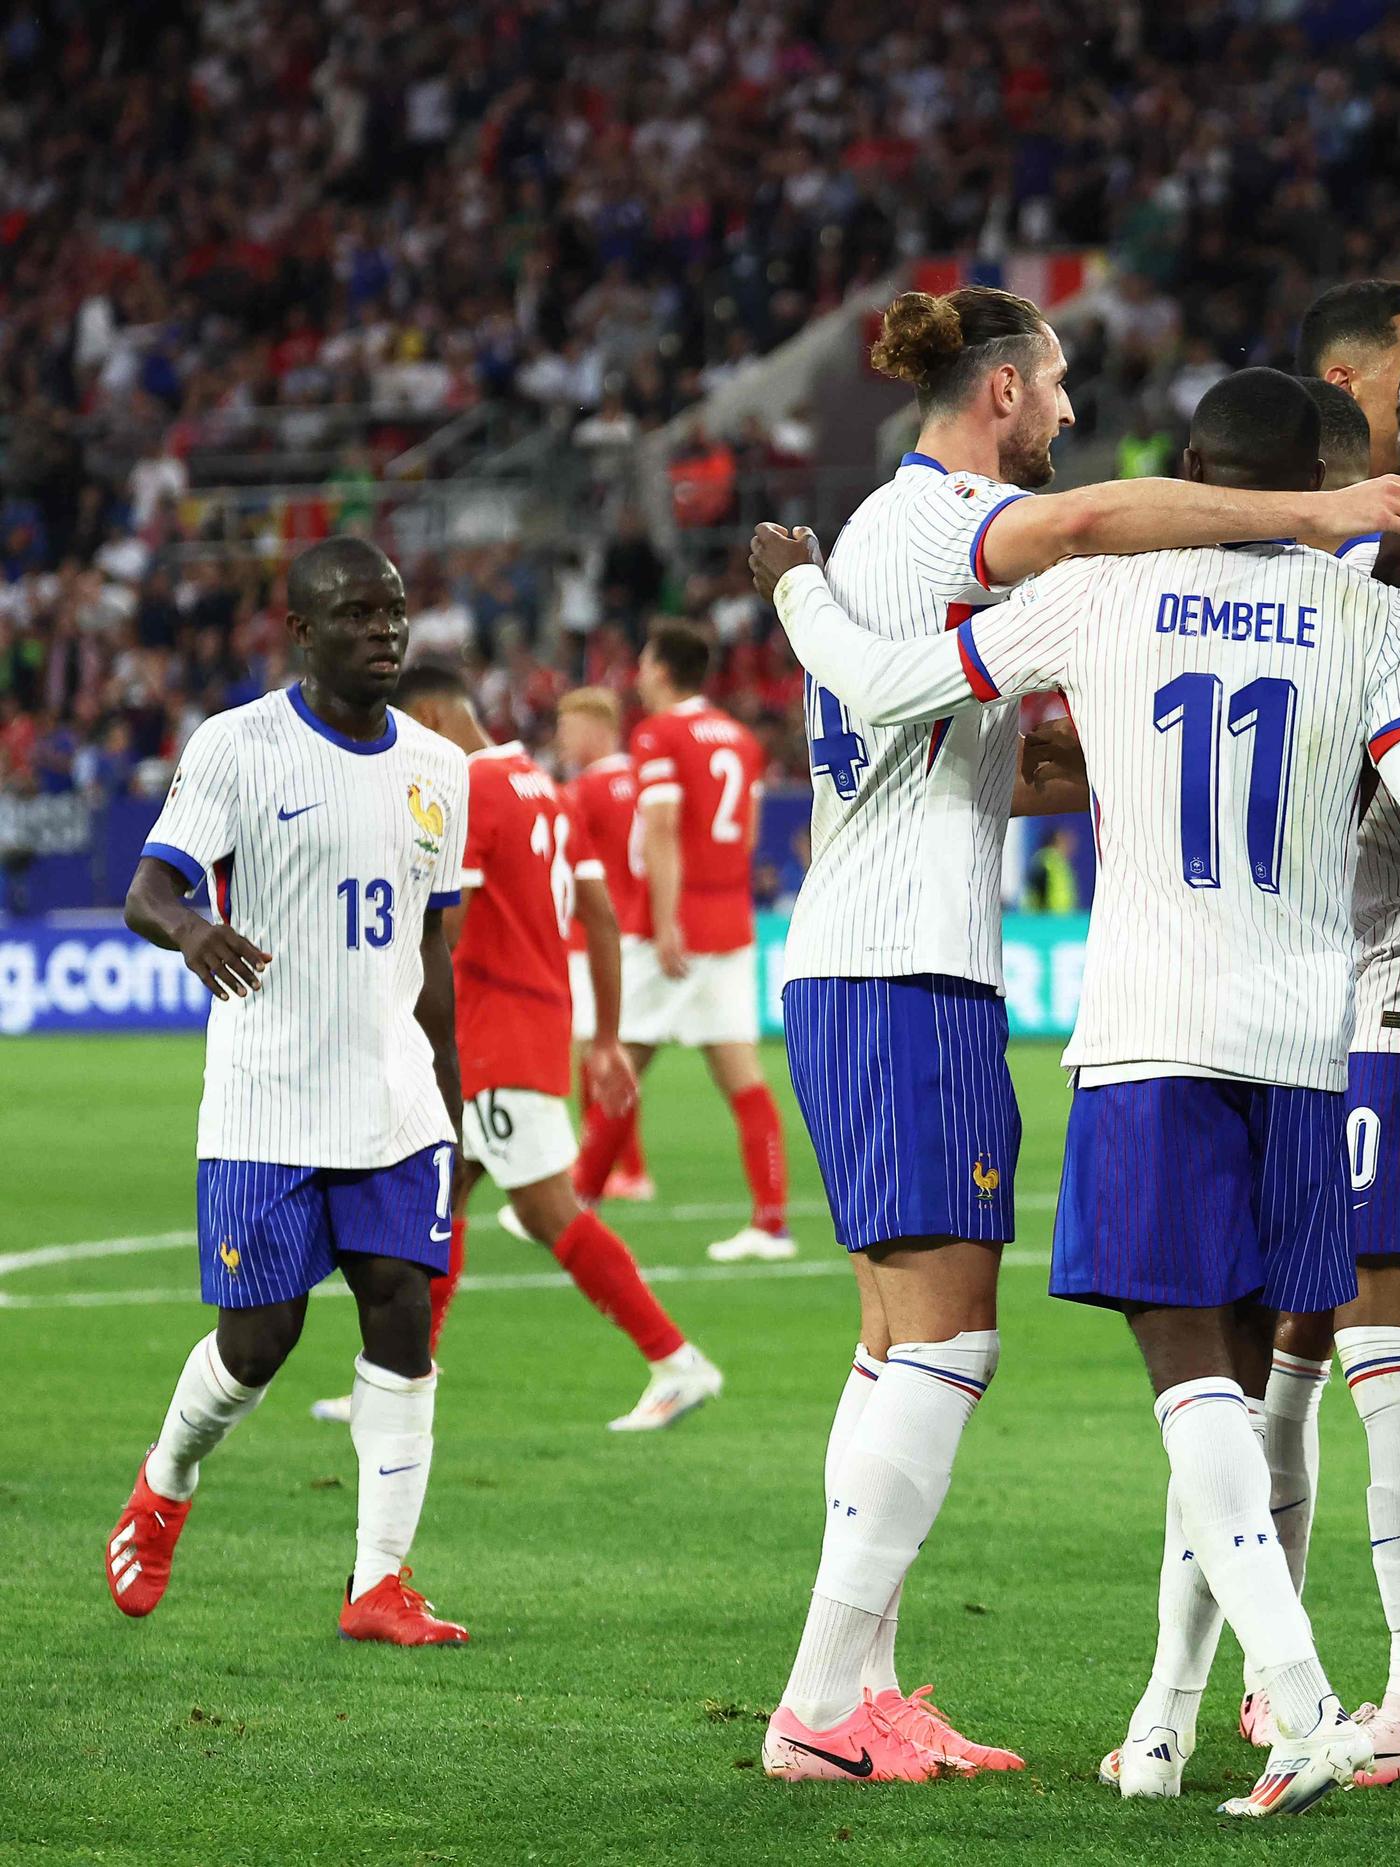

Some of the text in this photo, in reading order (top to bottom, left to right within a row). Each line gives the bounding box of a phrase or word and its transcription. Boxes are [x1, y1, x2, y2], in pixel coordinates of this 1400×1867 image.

[1155, 593, 1318, 648] DEMBELE
[708, 747, 744, 844] 2
[1153, 671, 1299, 895] 11
[337, 878, 395, 950] 13
